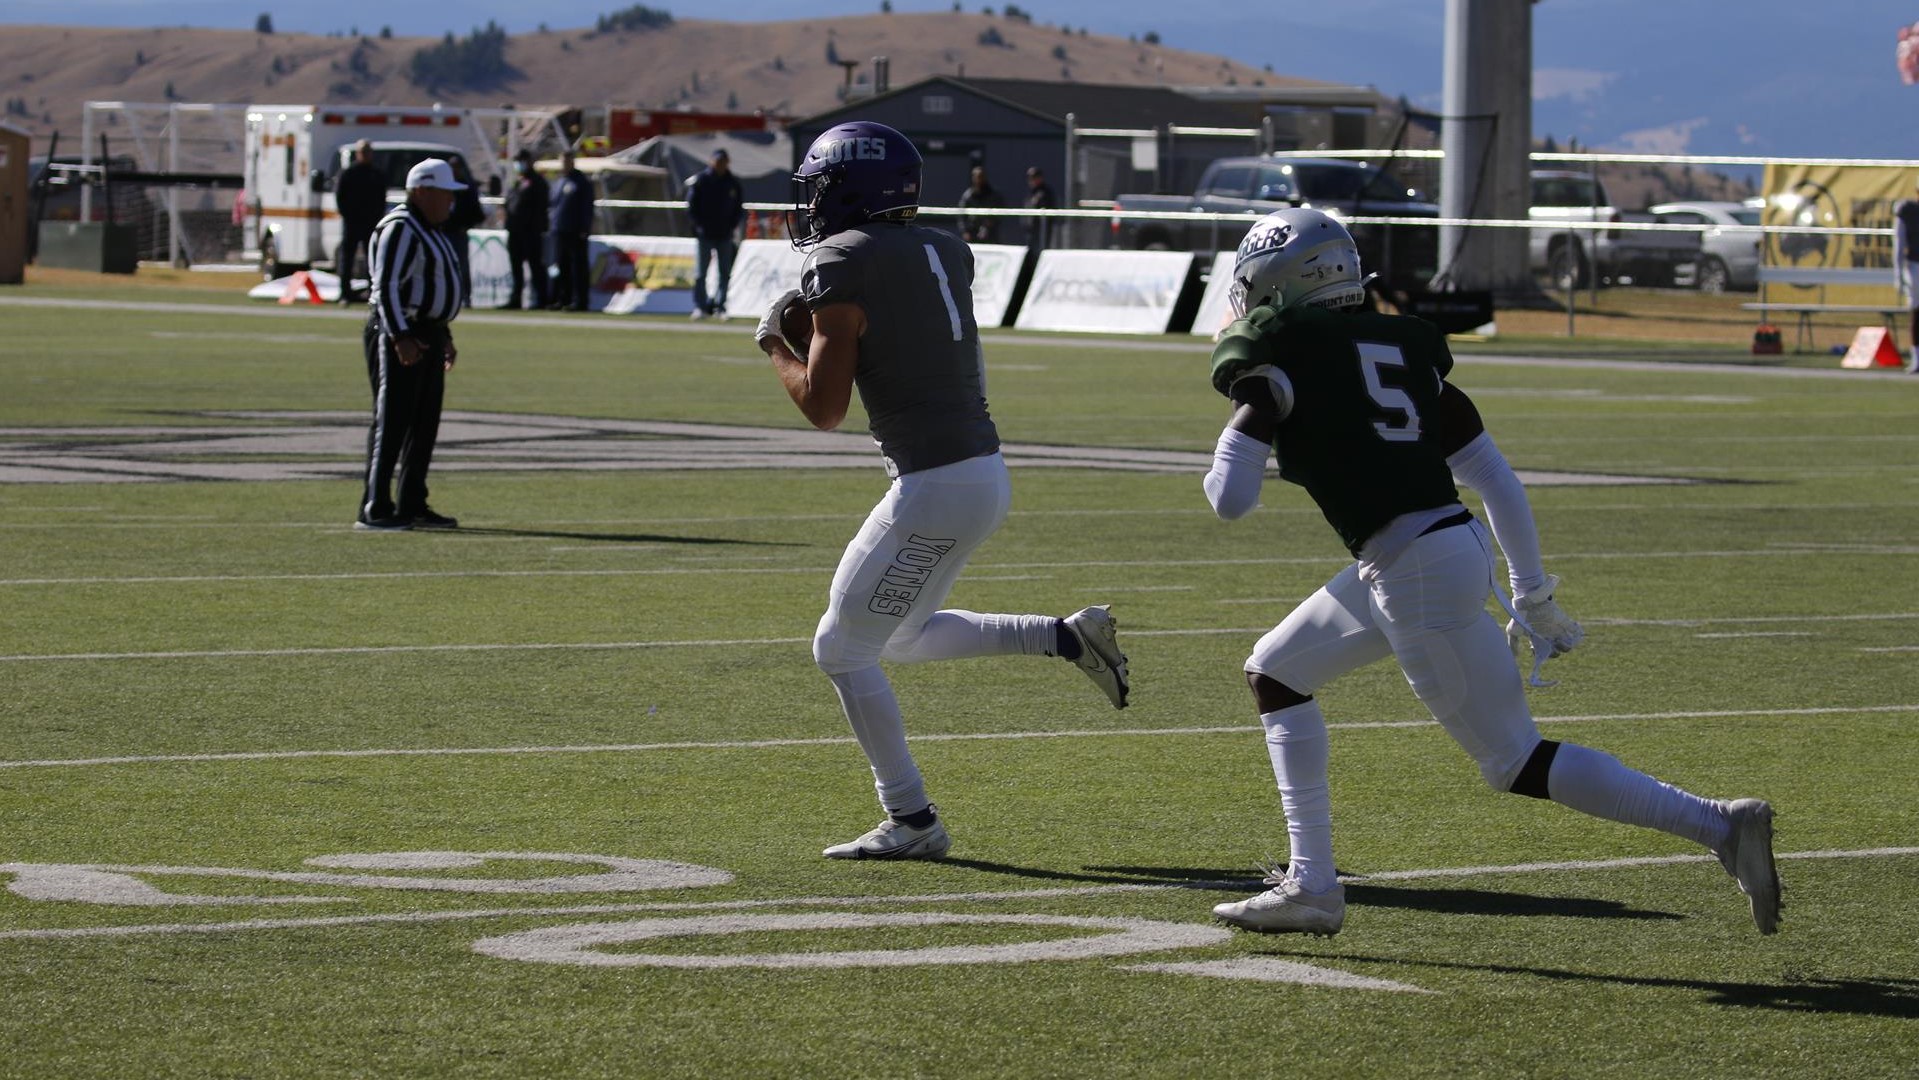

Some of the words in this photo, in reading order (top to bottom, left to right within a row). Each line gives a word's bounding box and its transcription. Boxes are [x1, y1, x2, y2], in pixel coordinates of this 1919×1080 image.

[924, 243, 963, 341] 1
[1355, 341, 1421, 442] 5
[867, 533, 957, 618] YOTES
